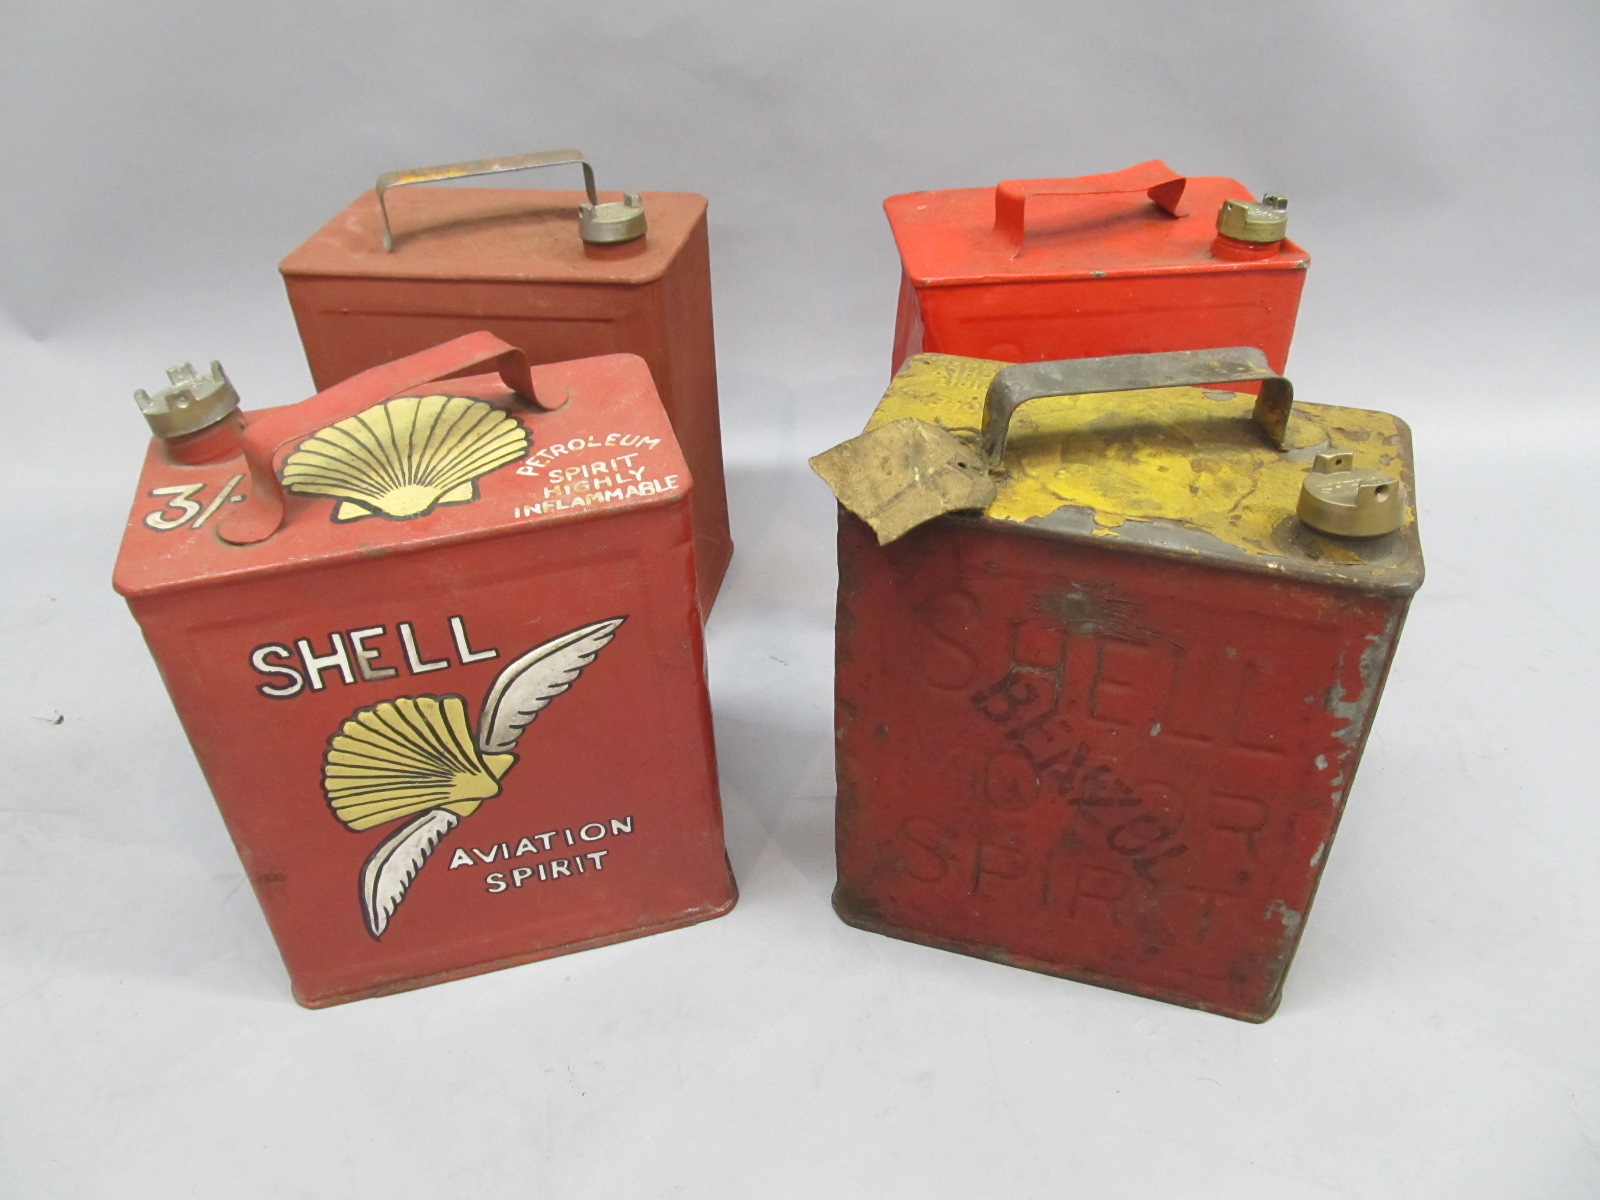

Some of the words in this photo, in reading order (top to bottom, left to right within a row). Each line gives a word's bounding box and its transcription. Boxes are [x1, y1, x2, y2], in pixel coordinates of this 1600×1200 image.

[516, 433, 661, 476] PETROLEUM
[549, 452, 639, 484] SPIRIT
[513, 474, 680, 519] INFLAMMABLE
[543, 466, 646, 499] HIGHLY
[250, 615, 500, 700] SHELL
[912, 588, 1287, 757] SHELL
[448, 816, 634, 870] AVIATION
[485, 850, 609, 894] SPIRIT
[899, 816, 1243, 942] SPIRT
